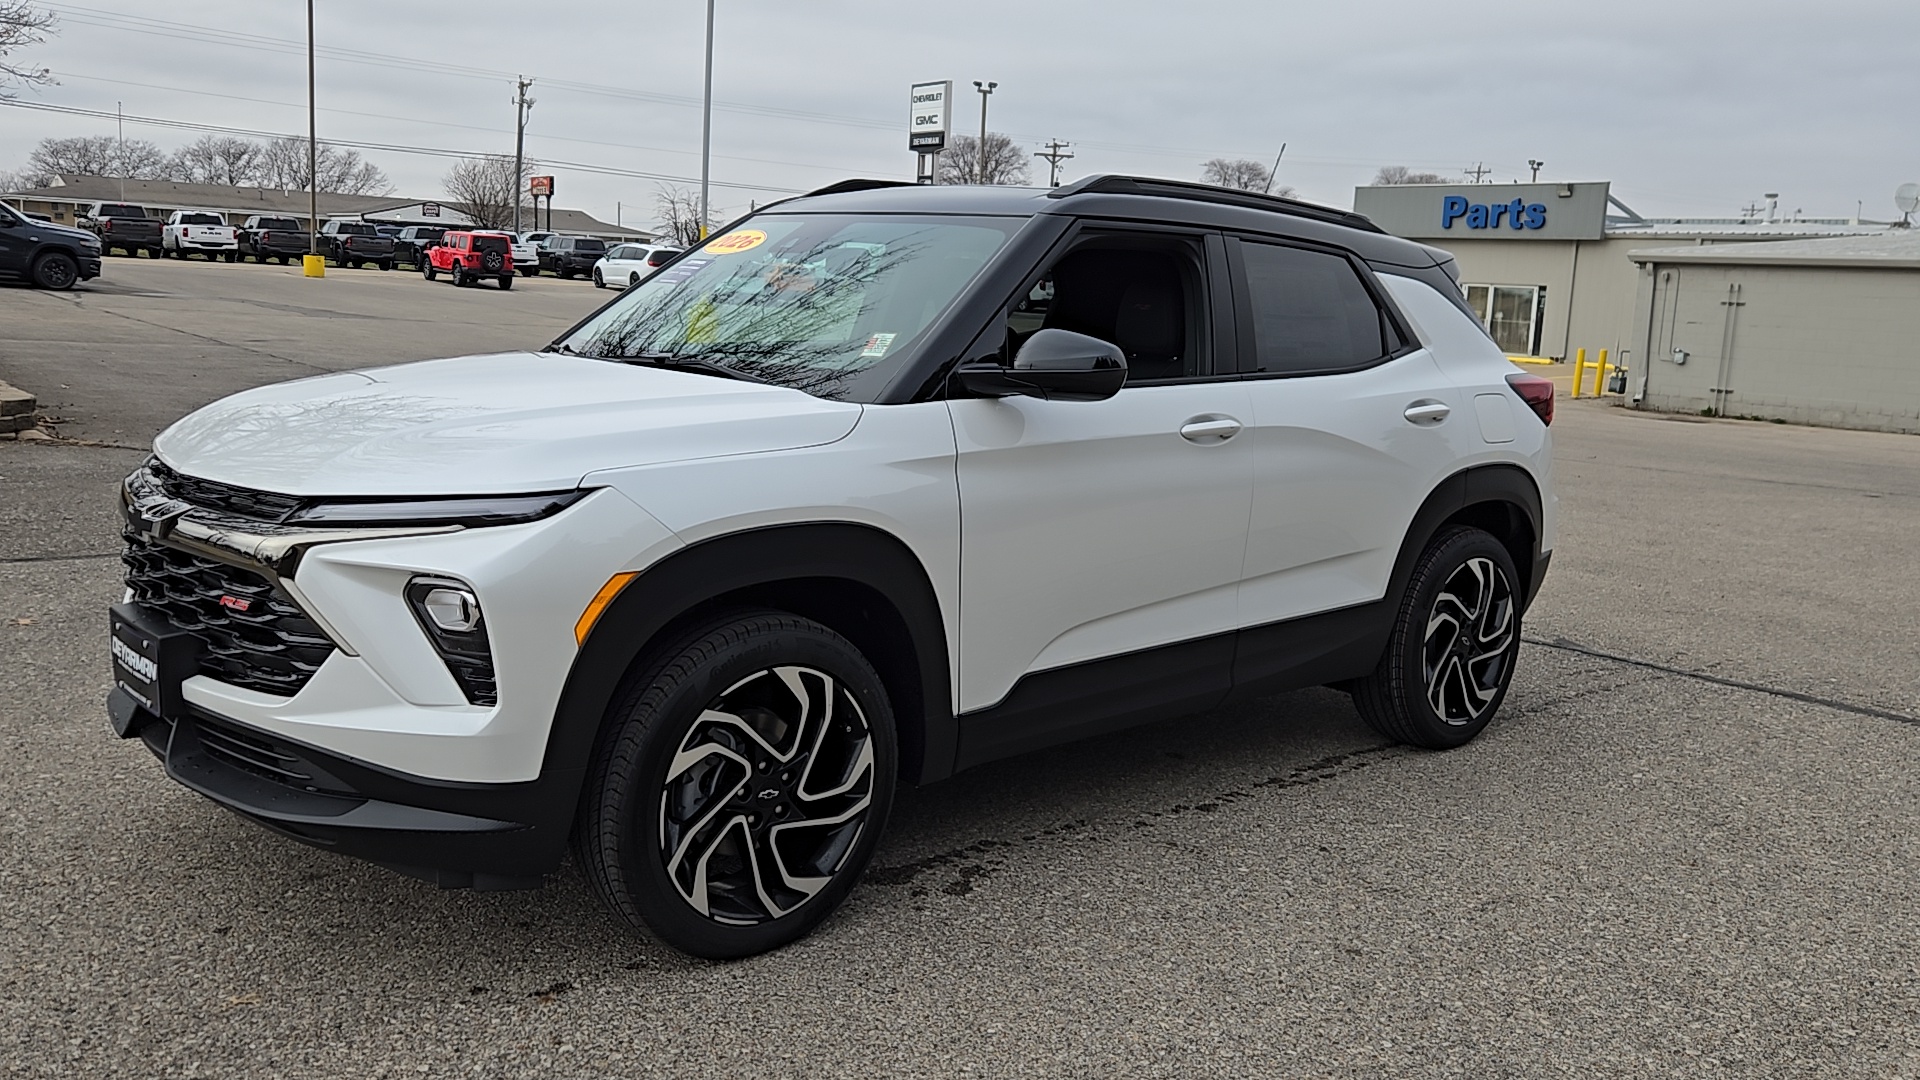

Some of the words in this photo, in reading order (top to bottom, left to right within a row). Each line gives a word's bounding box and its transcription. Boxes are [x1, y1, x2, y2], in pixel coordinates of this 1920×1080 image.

[913, 92, 942, 103] CHEVROLET
[915, 114, 938, 125] GMC
[1441, 195, 1547, 230] Parts
[708, 234, 762, 249] 2026
[218, 595, 251, 611] RS
[112, 635, 158, 681] DEYARMAN
